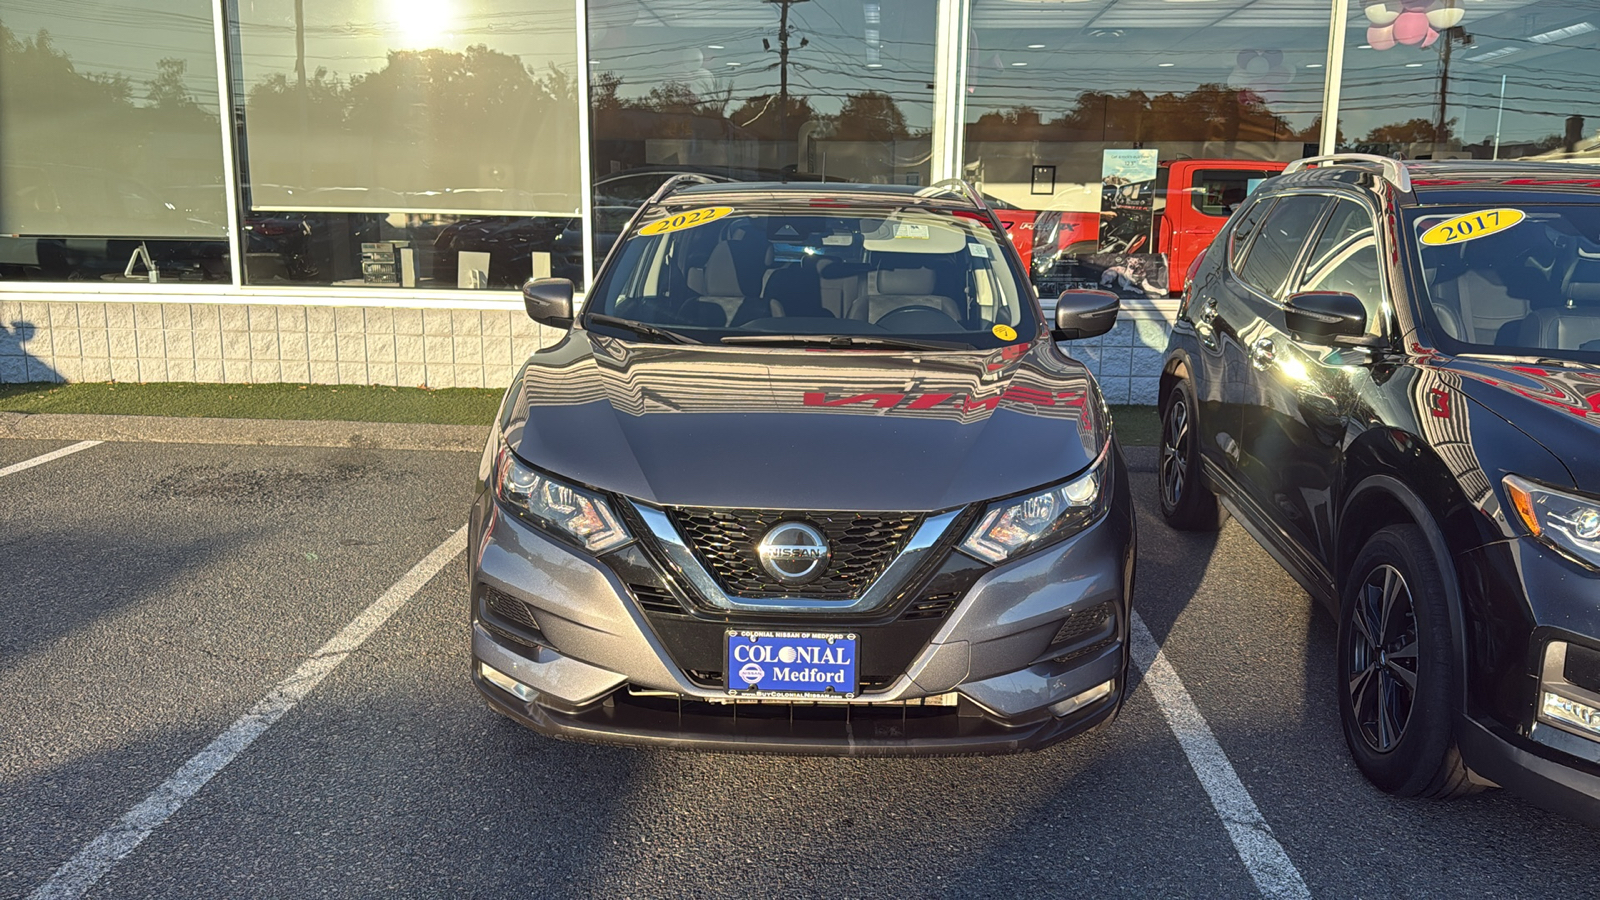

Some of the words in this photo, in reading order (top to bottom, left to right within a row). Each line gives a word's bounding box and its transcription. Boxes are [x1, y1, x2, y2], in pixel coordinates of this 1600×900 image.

[657, 209, 716, 232] 2022
[1440, 211, 1499, 241] 2017
[768, 548, 820, 557] NISSAN
[772, 667, 845, 683] Medford
